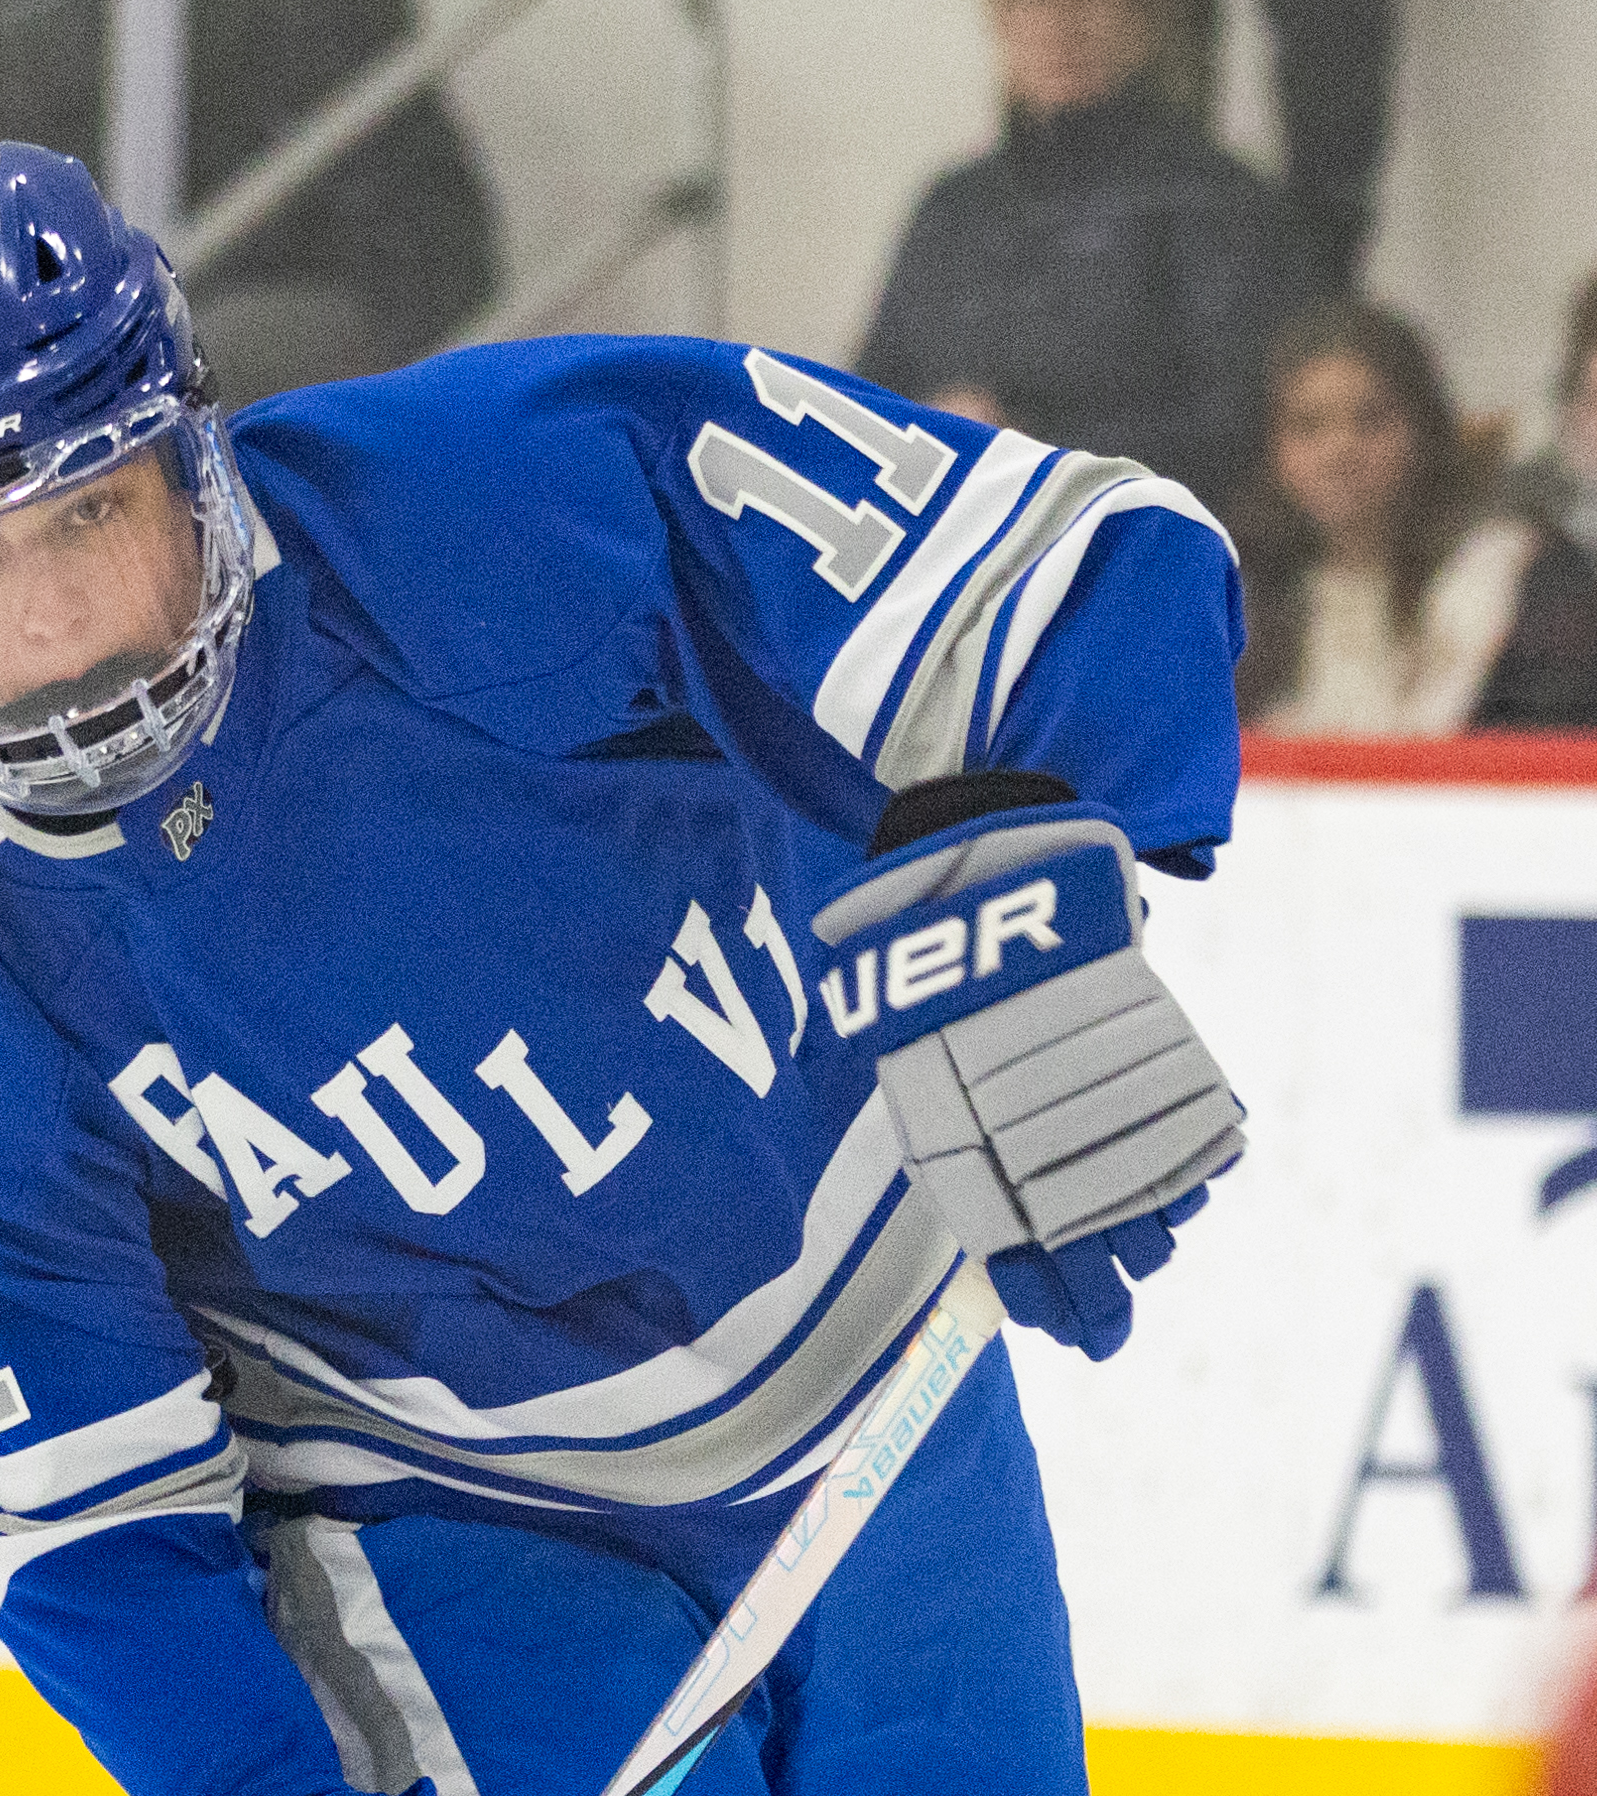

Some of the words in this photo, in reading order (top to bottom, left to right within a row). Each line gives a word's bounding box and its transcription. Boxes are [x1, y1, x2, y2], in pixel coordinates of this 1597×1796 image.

[688, 347, 958, 603] 11
[819, 877, 1065, 1039] UER
[108, 1022, 653, 1239] PAUL
